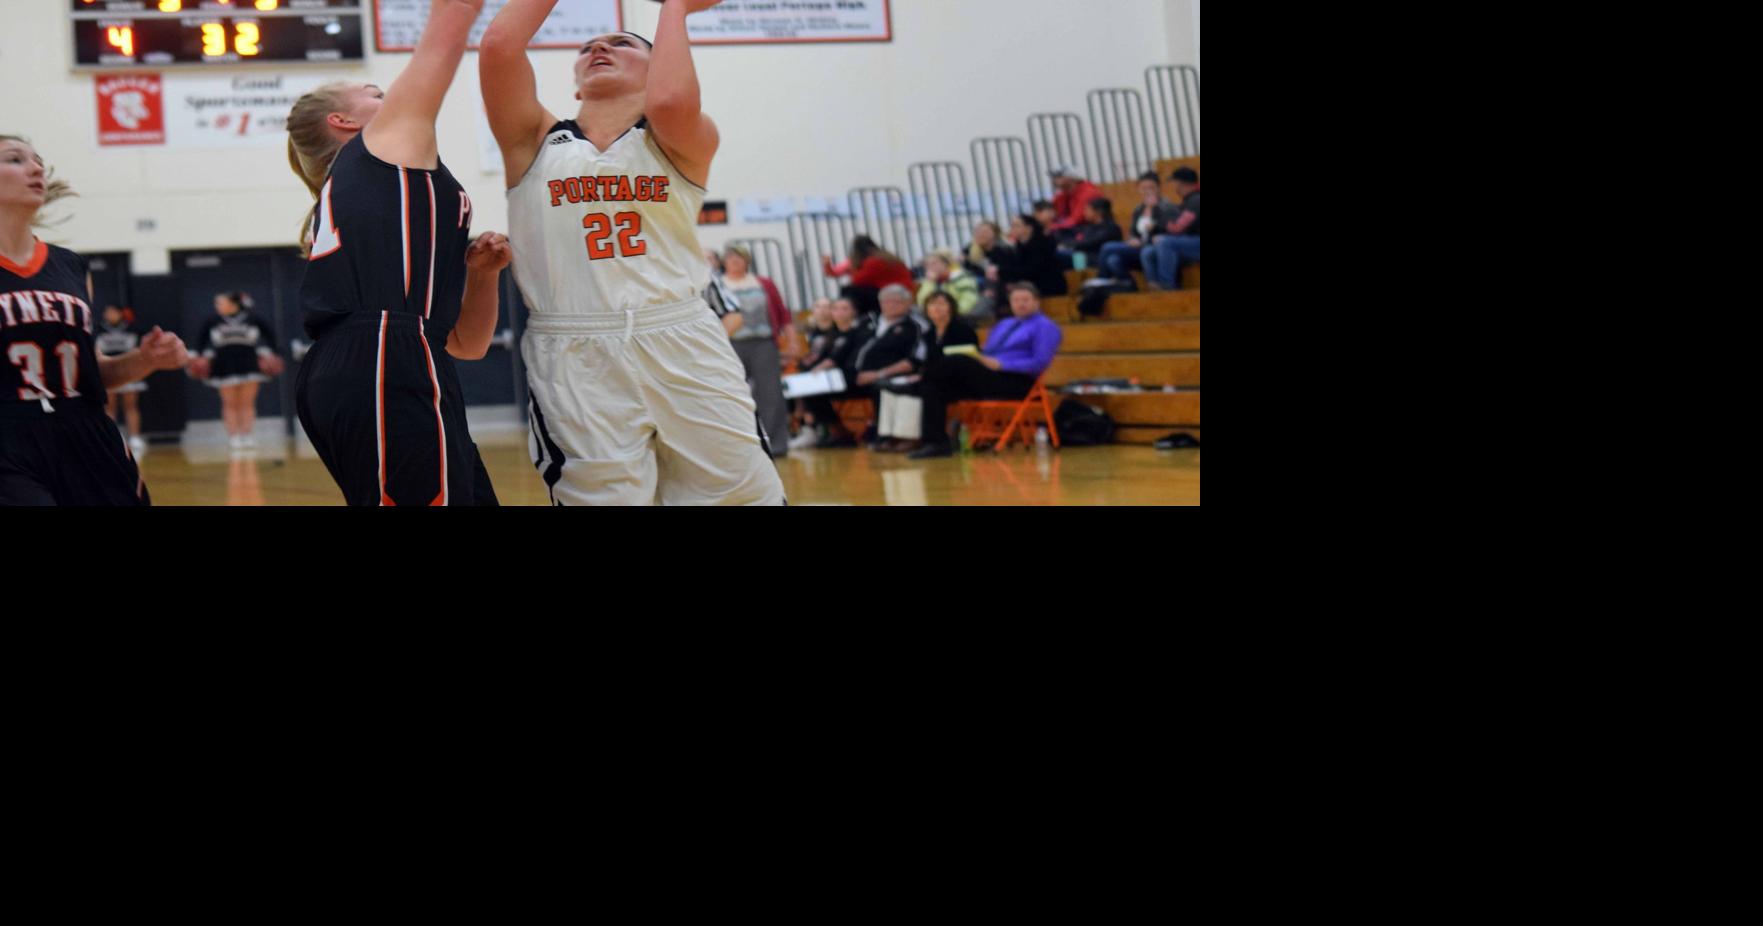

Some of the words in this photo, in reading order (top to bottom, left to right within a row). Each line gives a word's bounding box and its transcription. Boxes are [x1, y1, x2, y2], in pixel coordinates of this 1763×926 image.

[107, 26, 133, 56] 4
[548, 175, 669, 207] PORTAGE
[582, 211, 646, 260] 22
[7, 341, 81, 400] 31
